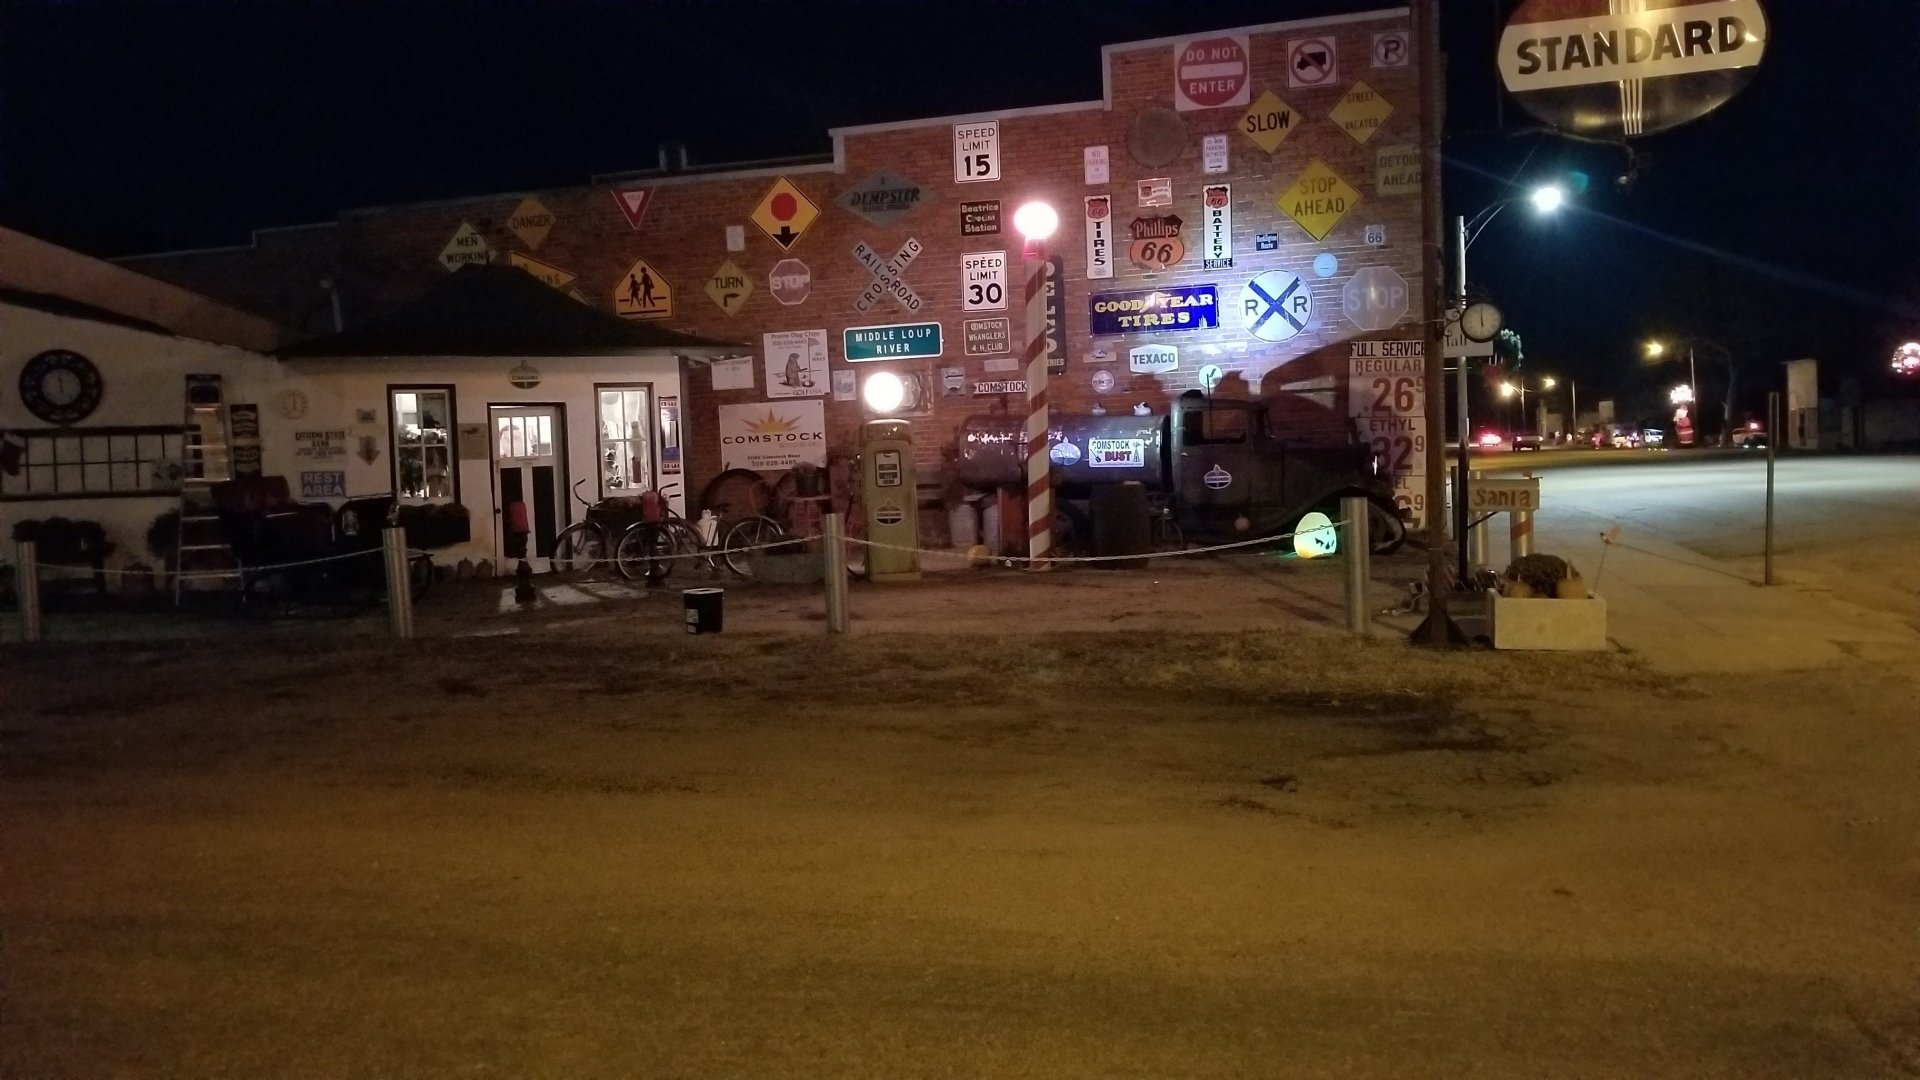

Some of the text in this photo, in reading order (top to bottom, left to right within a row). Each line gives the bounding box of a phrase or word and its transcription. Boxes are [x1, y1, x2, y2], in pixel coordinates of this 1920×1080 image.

[1516, 16, 1748, 75] STANDARD
[1186, 46, 1238, 62] DO NOT
[1189, 79, 1236, 95] ENTER
[1346, 91, 1374, 104] STREET
[1246, 110, 1290, 133] SLOW
[958, 127, 995, 140] SPEED
[962, 140, 991, 152] LIMIT
[964, 153, 991, 176] 15
[1301, 177, 1337, 195] STOP
[850, 187, 920, 206] DEMPSTER
[961, 204, 999, 214] Beatrice
[1092, 208, 1104, 216] 66
[1294, 198, 1345, 217] AHEAD
[513, 214, 551, 230] DANGER
[965, 223, 997, 233] Station
[1135, 219, 1179, 239] Phillips
[1213, 210, 1223, 259] BATTERY
[456, 237, 478, 247] MEN
[1093, 221, 1106, 266] TIRES
[1368, 232, 1382, 243] 66
[446, 252, 491, 265] WORKING
[1141, 241, 1174, 264] 66
[965, 258, 1002, 269] SPEED
[1205, 259, 1231, 269] SERVICE
[714, 276, 744, 289] TURN
[771, 275, 810, 290] STOP
[857, 241, 919, 311] CROSSING
[969, 271, 999, 281] LIMIT
[968, 283, 1003, 305] 30
[1350, 286, 1403, 311] STOP
[1245, 296, 1308, 317] R R
[970, 321, 1003, 331] COMSTOCK
[1118, 311, 1191, 328] TIRES
[855, 328, 932, 343] MIDDLE LOUP
[876, 343, 911, 355] RIVER
[1350, 342, 1376, 357] FULL
[1132, 352, 1175, 365] TEXACO
[1355, 359, 1421, 373] REGULAR
[978, 381, 1028, 393] COMSTOCK
[1370, 418, 1416, 431] ETHYL
[722, 431, 823, 444] COMSTOCK
[1092, 440, 1130, 449] COMSTOCK
[304, 472, 342, 484] REST
[303, 484, 343, 496] AREA
